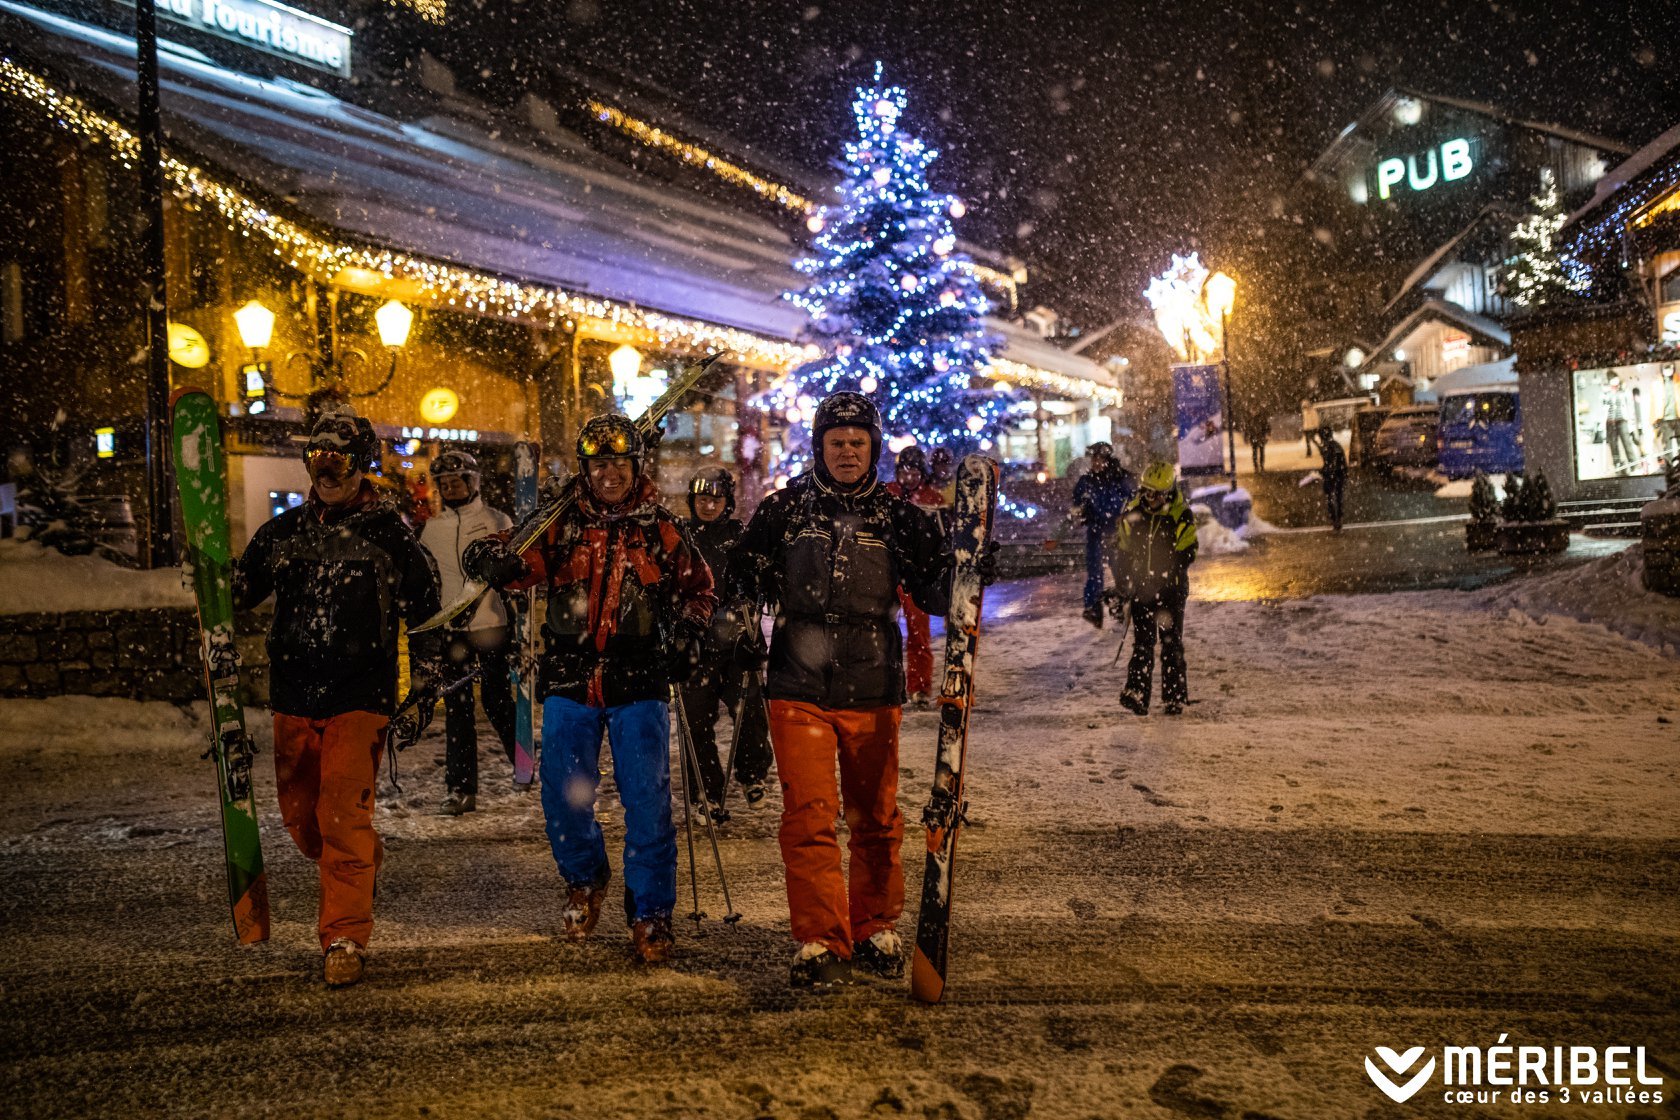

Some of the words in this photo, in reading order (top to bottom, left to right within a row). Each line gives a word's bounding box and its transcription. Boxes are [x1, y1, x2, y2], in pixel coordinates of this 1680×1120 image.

[202, 0, 342, 68] Tourisme
[1378, 138, 1473, 200] PUB
[402, 426, 423, 438] LA
[429, 427, 478, 441] POSTE
[350, 569, 363, 577] Rab
